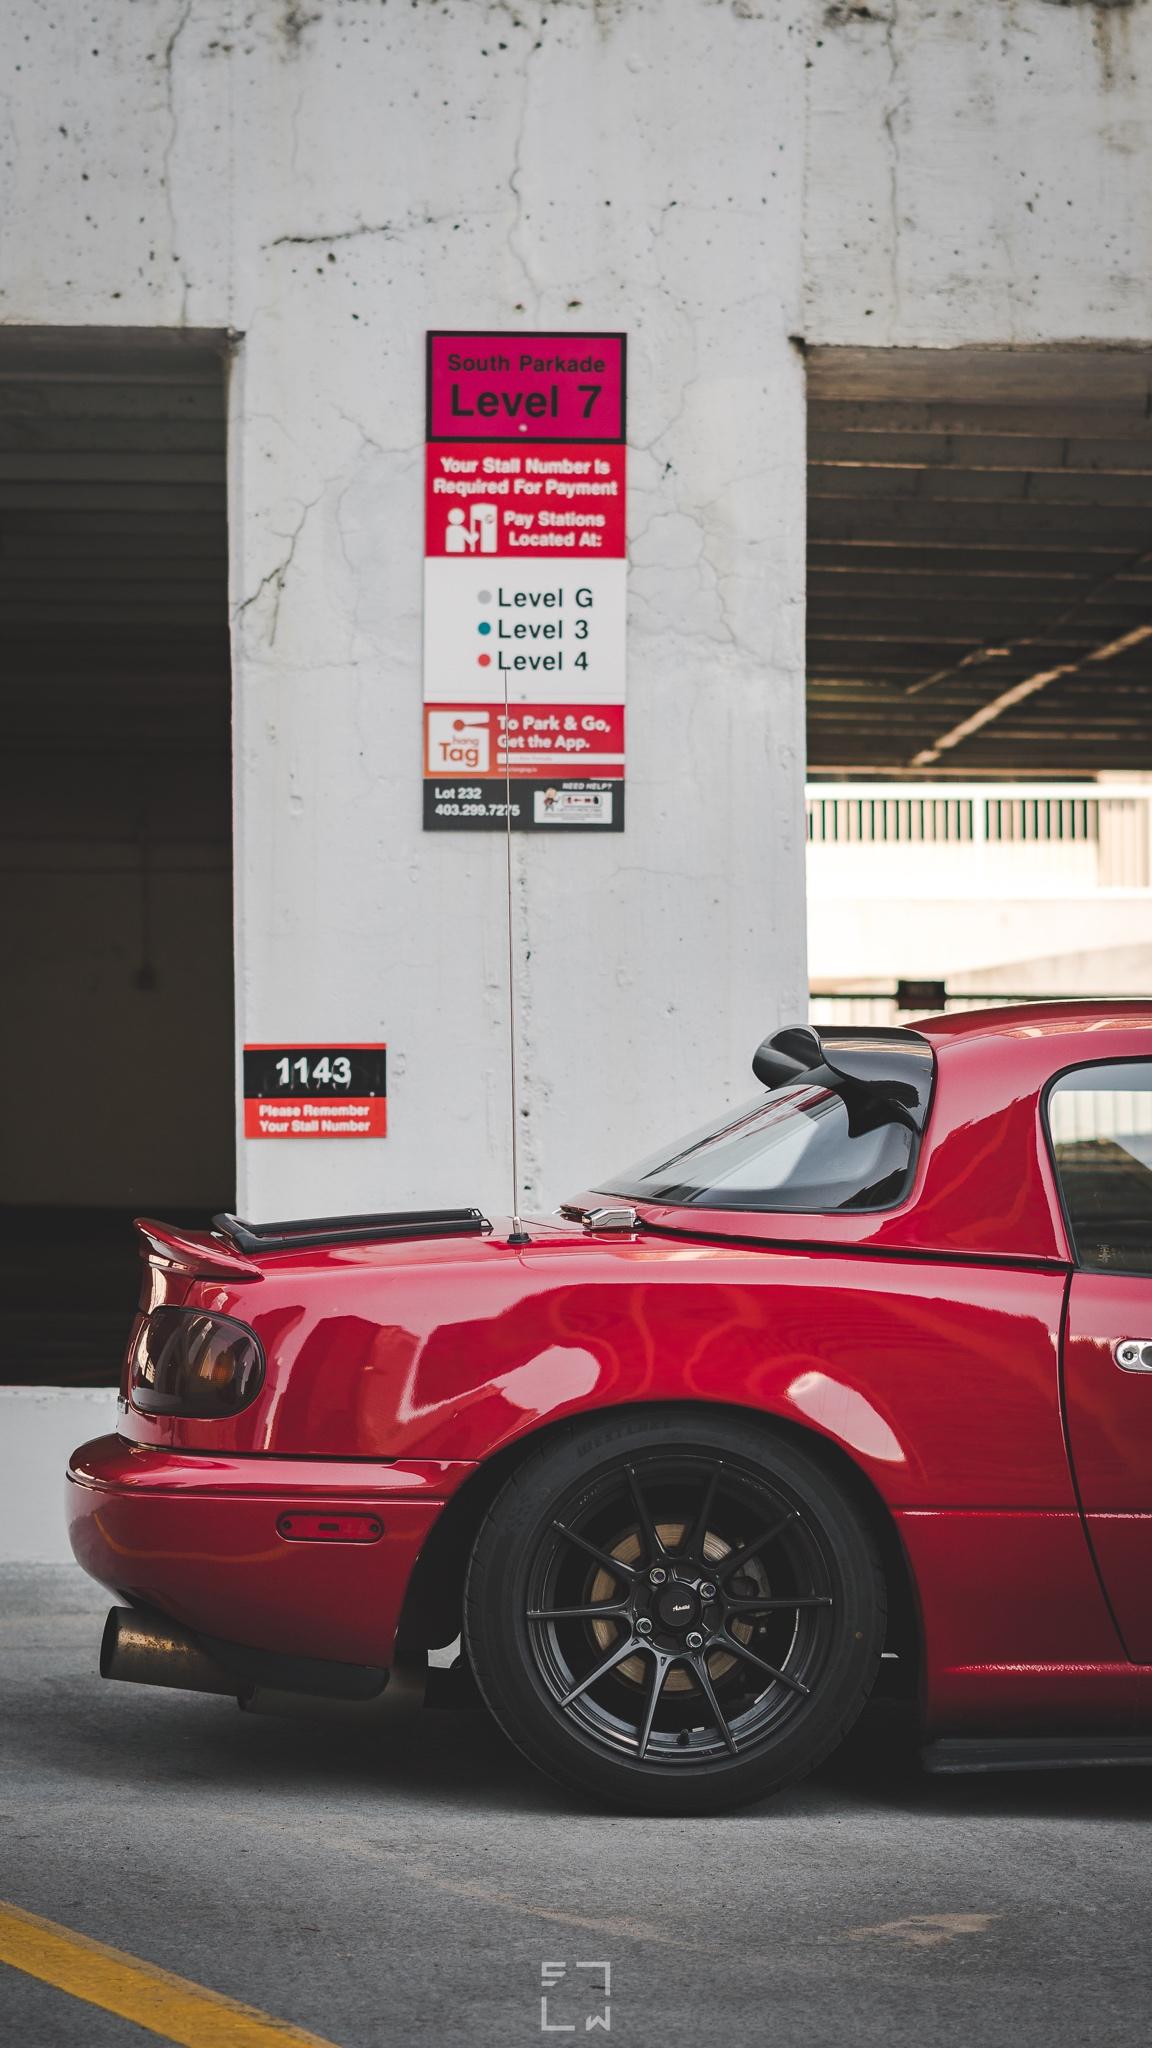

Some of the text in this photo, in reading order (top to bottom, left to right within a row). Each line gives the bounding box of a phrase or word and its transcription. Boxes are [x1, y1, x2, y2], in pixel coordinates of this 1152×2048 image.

[448, 354, 606, 372] South Parkade
[452, 384, 602, 418] Level 7
[440, 457, 611, 475] Your Stall Number Is
[433, 478, 618, 498] Required For Payment
[504, 510, 606, 529] Pay Stations
[509, 531, 602, 548] Located At:
[498, 588, 593, 608] Level G
[498, 619, 589, 639] Level 3
[498, 651, 589, 671] Level 4
[497, 715, 611, 733] To Park & Go,
[497, 735, 590, 752] Get the App.
[439, 742, 480, 767] Tag
[435, 787, 482, 800] Lot 232
[562, 782, 585, 790] NEED
[435, 803, 520, 817] 403.299.7275
[275, 1056, 352, 1084] 1143
[259, 1104, 370, 1117] Please Remember
[259, 1120, 371, 1133] Your Stall Number
